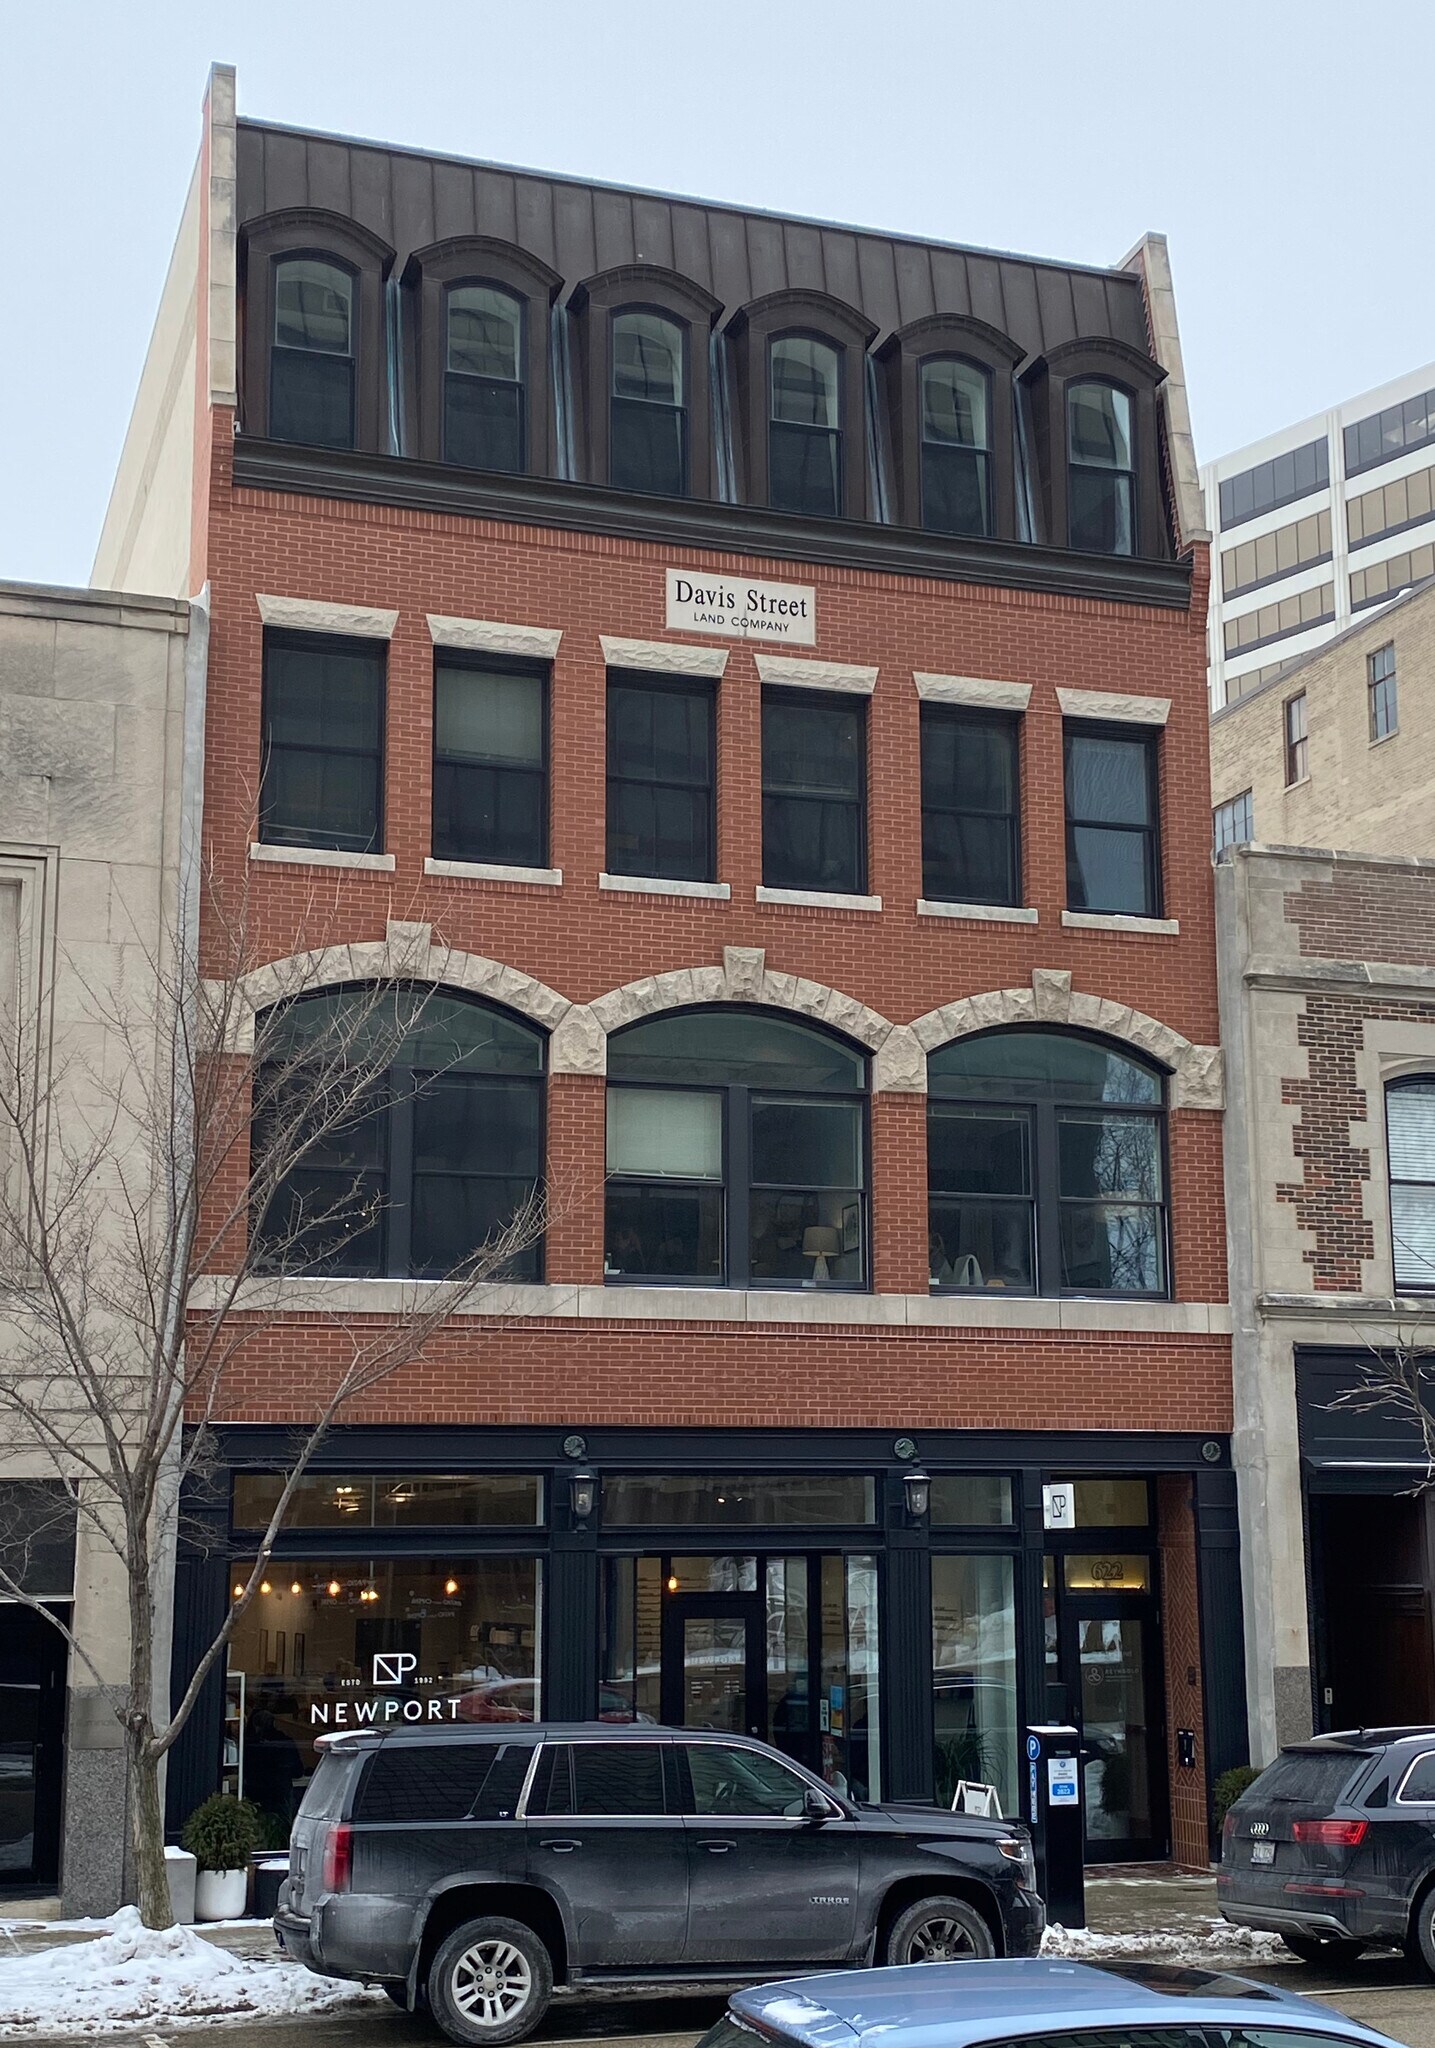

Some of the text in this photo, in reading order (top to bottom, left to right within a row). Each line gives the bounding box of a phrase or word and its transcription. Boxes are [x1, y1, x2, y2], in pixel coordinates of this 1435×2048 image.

[675, 580, 807, 618] Davis Street
[693, 612, 789, 632] LAND COMPANY
[1091, 1561, 1124, 1580] 622
[311, 1699, 461, 1723] NEWPORT
